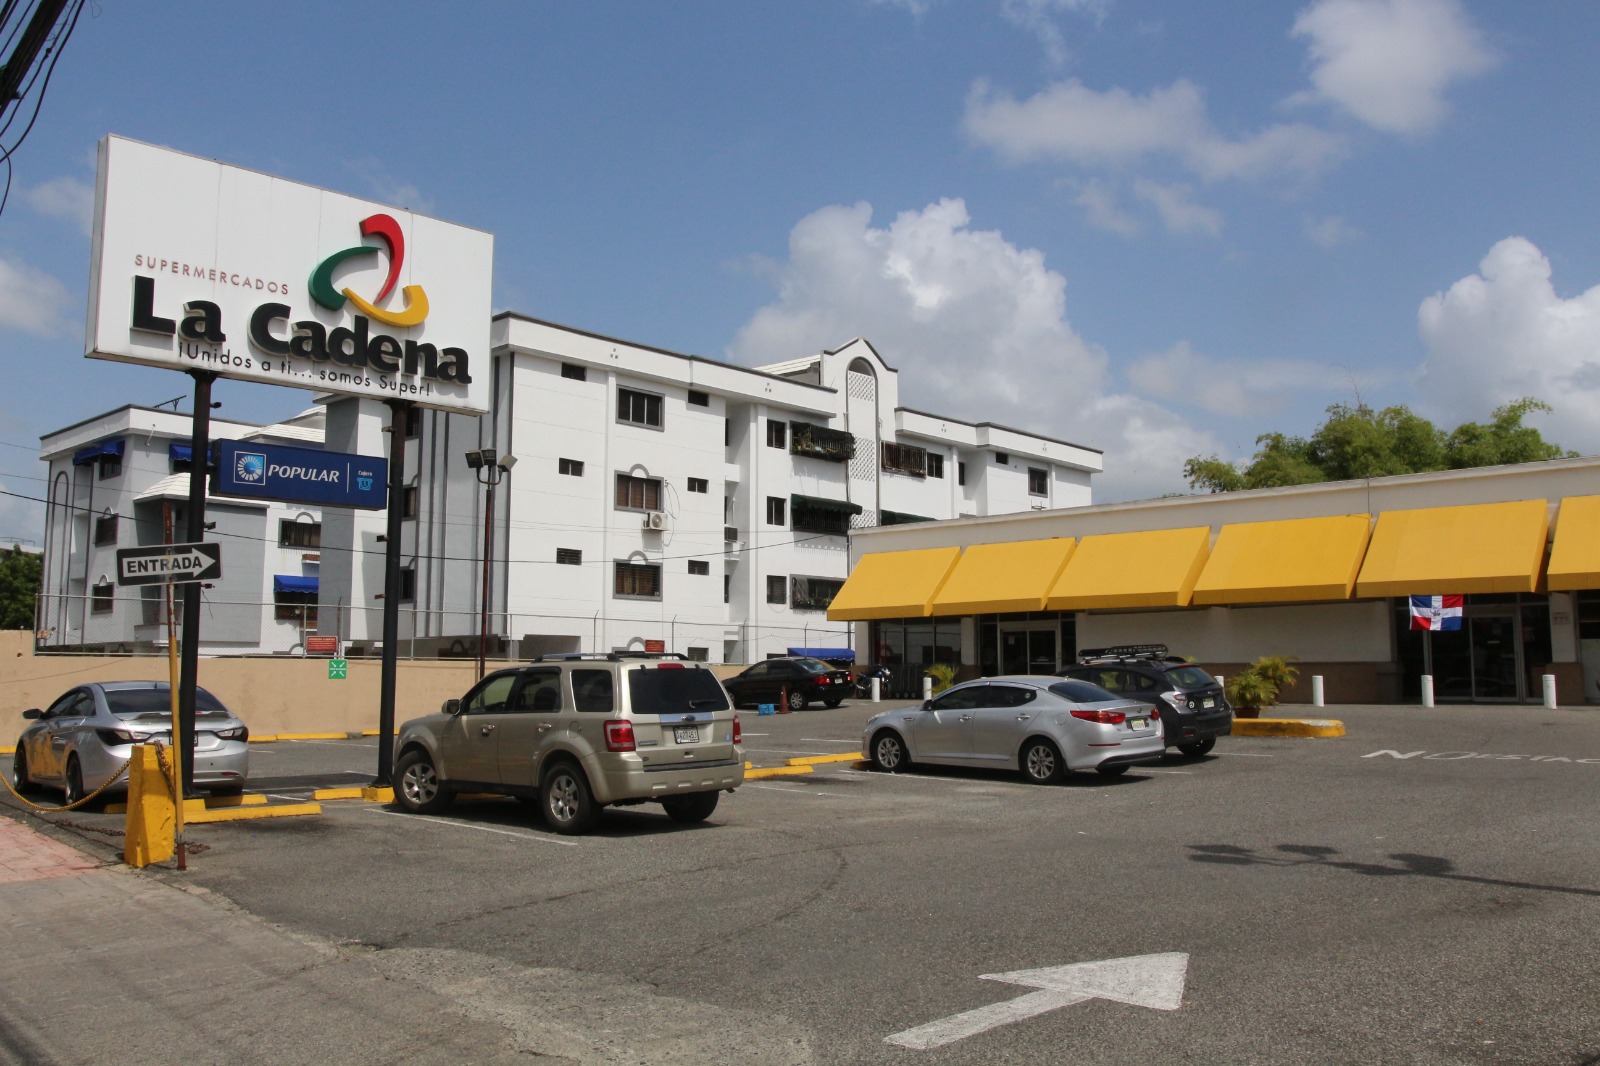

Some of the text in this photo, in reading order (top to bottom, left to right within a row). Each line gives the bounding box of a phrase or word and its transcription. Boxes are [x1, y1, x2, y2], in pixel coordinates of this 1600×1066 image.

[134, 254, 290, 295] SUPERMERCADOS
[131, 274, 473, 385] La Cadena
[179, 342, 430, 397] ¡Unidos a ti... somos Super!
[267, 464, 340, 483] POPULAR
[127, 556, 203, 574] ENTRADA
[1360, 750, 1478, 760] NO
